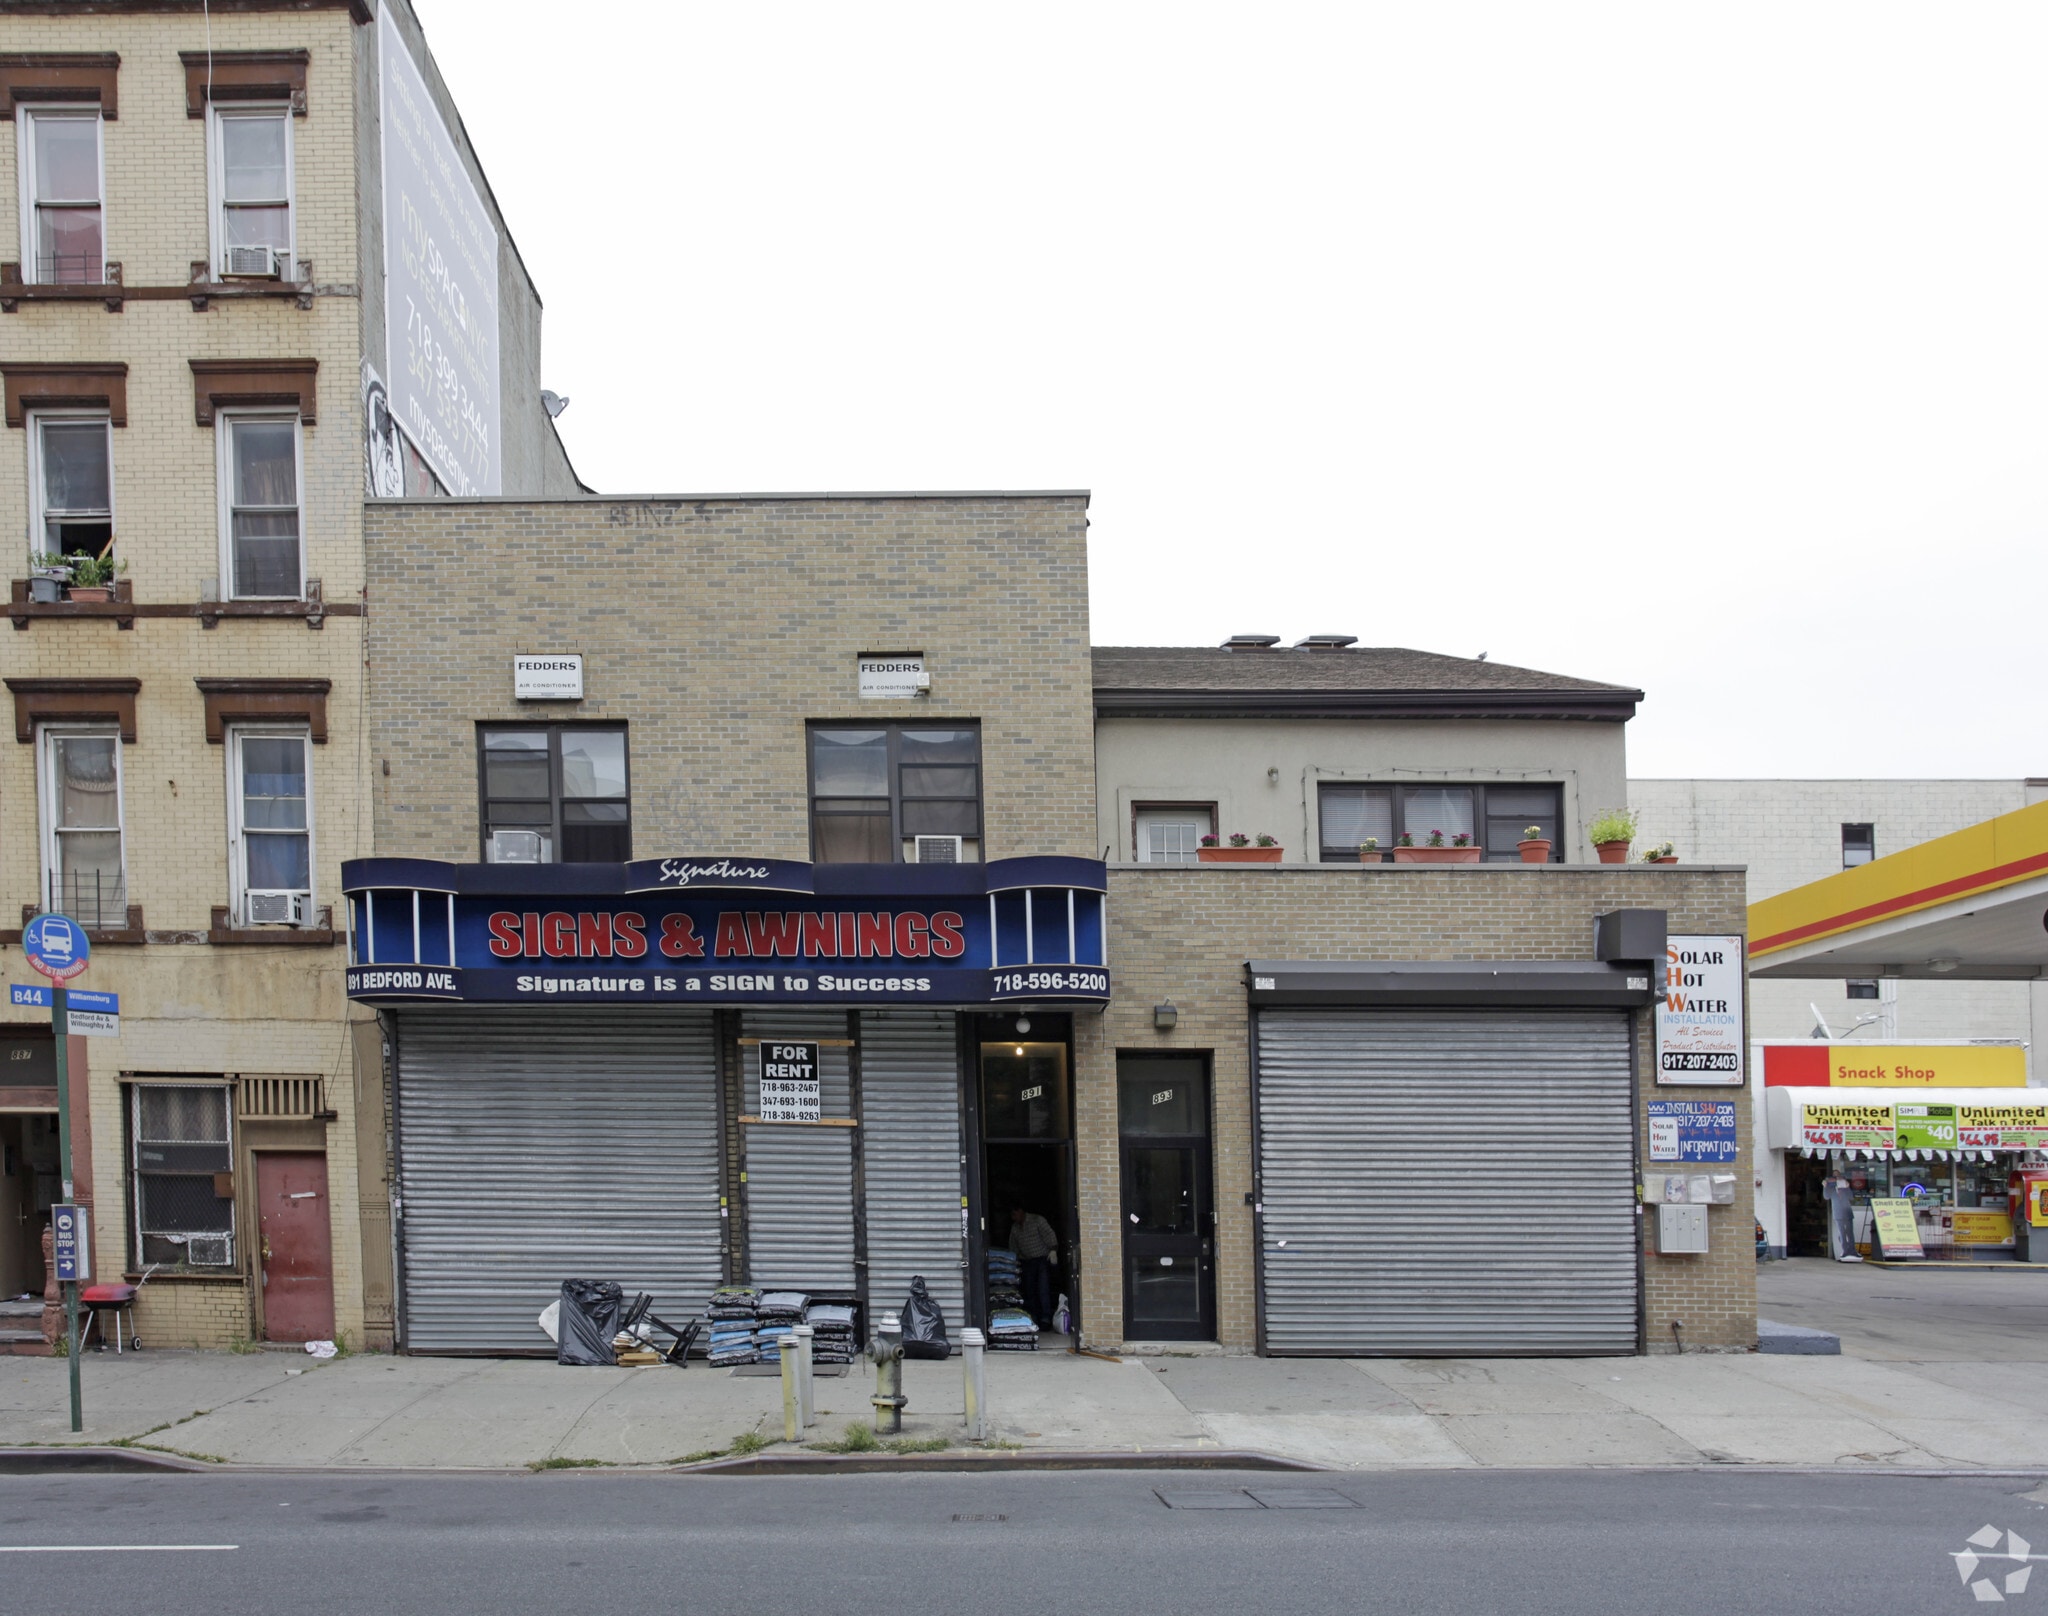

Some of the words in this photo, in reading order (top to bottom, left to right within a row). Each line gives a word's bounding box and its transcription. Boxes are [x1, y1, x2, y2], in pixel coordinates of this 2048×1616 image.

[402, 236, 418, 280] NO
[420, 266, 436, 314] FEE
[438, 299, 490, 405] APARTMENTS
[406, 294, 432, 362] 718
[436, 341, 458, 401] 399
[461, 384, 489, 454] 3444
[408, 336, 433, 397] 347
[437, 381, 459, 441] 533
[462, 421, 490, 486] 7777
[518, 661, 577, 671] FEDDERS
[861, 663, 920, 673] FEDDERS
[660, 859, 770, 886] Signature
[488, 911, 648, 958] SIGNS
[659, 912, 706, 958] &
[714, 911, 966, 958] AWNINGS
[1666, 944, 1723, 965] SOLAR
[32, 957, 45, 969] NO
[45, 961, 84, 976] STANDING
[347, 973, 360, 991] 891
[362, 971, 422, 989] BEDFORD
[425, 972, 457, 991] AVE.
[516, 975, 645, 993] Signature
[654, 975, 677, 991] is
[685, 978, 701, 991] a
[709, 975, 775, 991] SIGN
[783, 976, 809, 991] to
[817, 975, 931, 991] Success
[993, 972, 1107, 993] 718-596-5200
[1666, 967, 1706, 987] HOT
[14, 989, 43, 1004] B44
[68, 992, 110, 1004] Williamsburg
[1666, 992, 1727, 1013] WATER
[70, 1013, 95, 1021] Bedford
[96, 1014, 104, 1022] Av
[1664, 1014, 1735, 1025] INSTALLATION
[70, 1021, 104, 1030] Willoughby
[1675, 1026, 1689, 1036] All
[1692, 1026, 1724, 1037] Services
[1662, 1040, 1694, 1051] Product
[1695, 1040, 1737, 1051] Distributor
[12, 1050, 31, 1060] 887
[772, 1046, 808, 1060] FOR
[1663, 1054, 1737, 1069] 917-207-2403
[765, 1063, 813, 1078] RENT
[1838, 1066, 1886, 1079] Snack
[1894, 1066, 1936, 1082] Shop
[761, 1082, 819, 1093] 718-963-2467
[1022, 1087, 1041, 1100] 891
[762, 1096, 819, 1106] 347-693-1600
[1153, 1090, 1172, 1104] 893
[762, 1110, 819, 1121] 718-384-9263
[1807, 1104, 1890, 1118] Unlimited
[1961, 1106, 2046, 1119] Unlimited
[1652, 1121, 1674, 1130] SOLAR
[1678, 1115, 1735, 1127] 917-207-2403
[1816, 1118, 1841, 1126] Talk
[1855, 1118, 1882, 1126] Text
[1970, 1118, 1996, 1126] Talk
[2011, 1118, 2038, 1126] Text
[1652, 1133, 1668, 1141] HOT
[1804, 1131, 1843, 1145] $44.95
[1927, 1126, 1955, 1140] $40
[1652, 1144, 1676, 1153] WATER
[1680, 1140, 1735, 1157] INFORMATION
[57, 1240, 75, 1248] STOP
